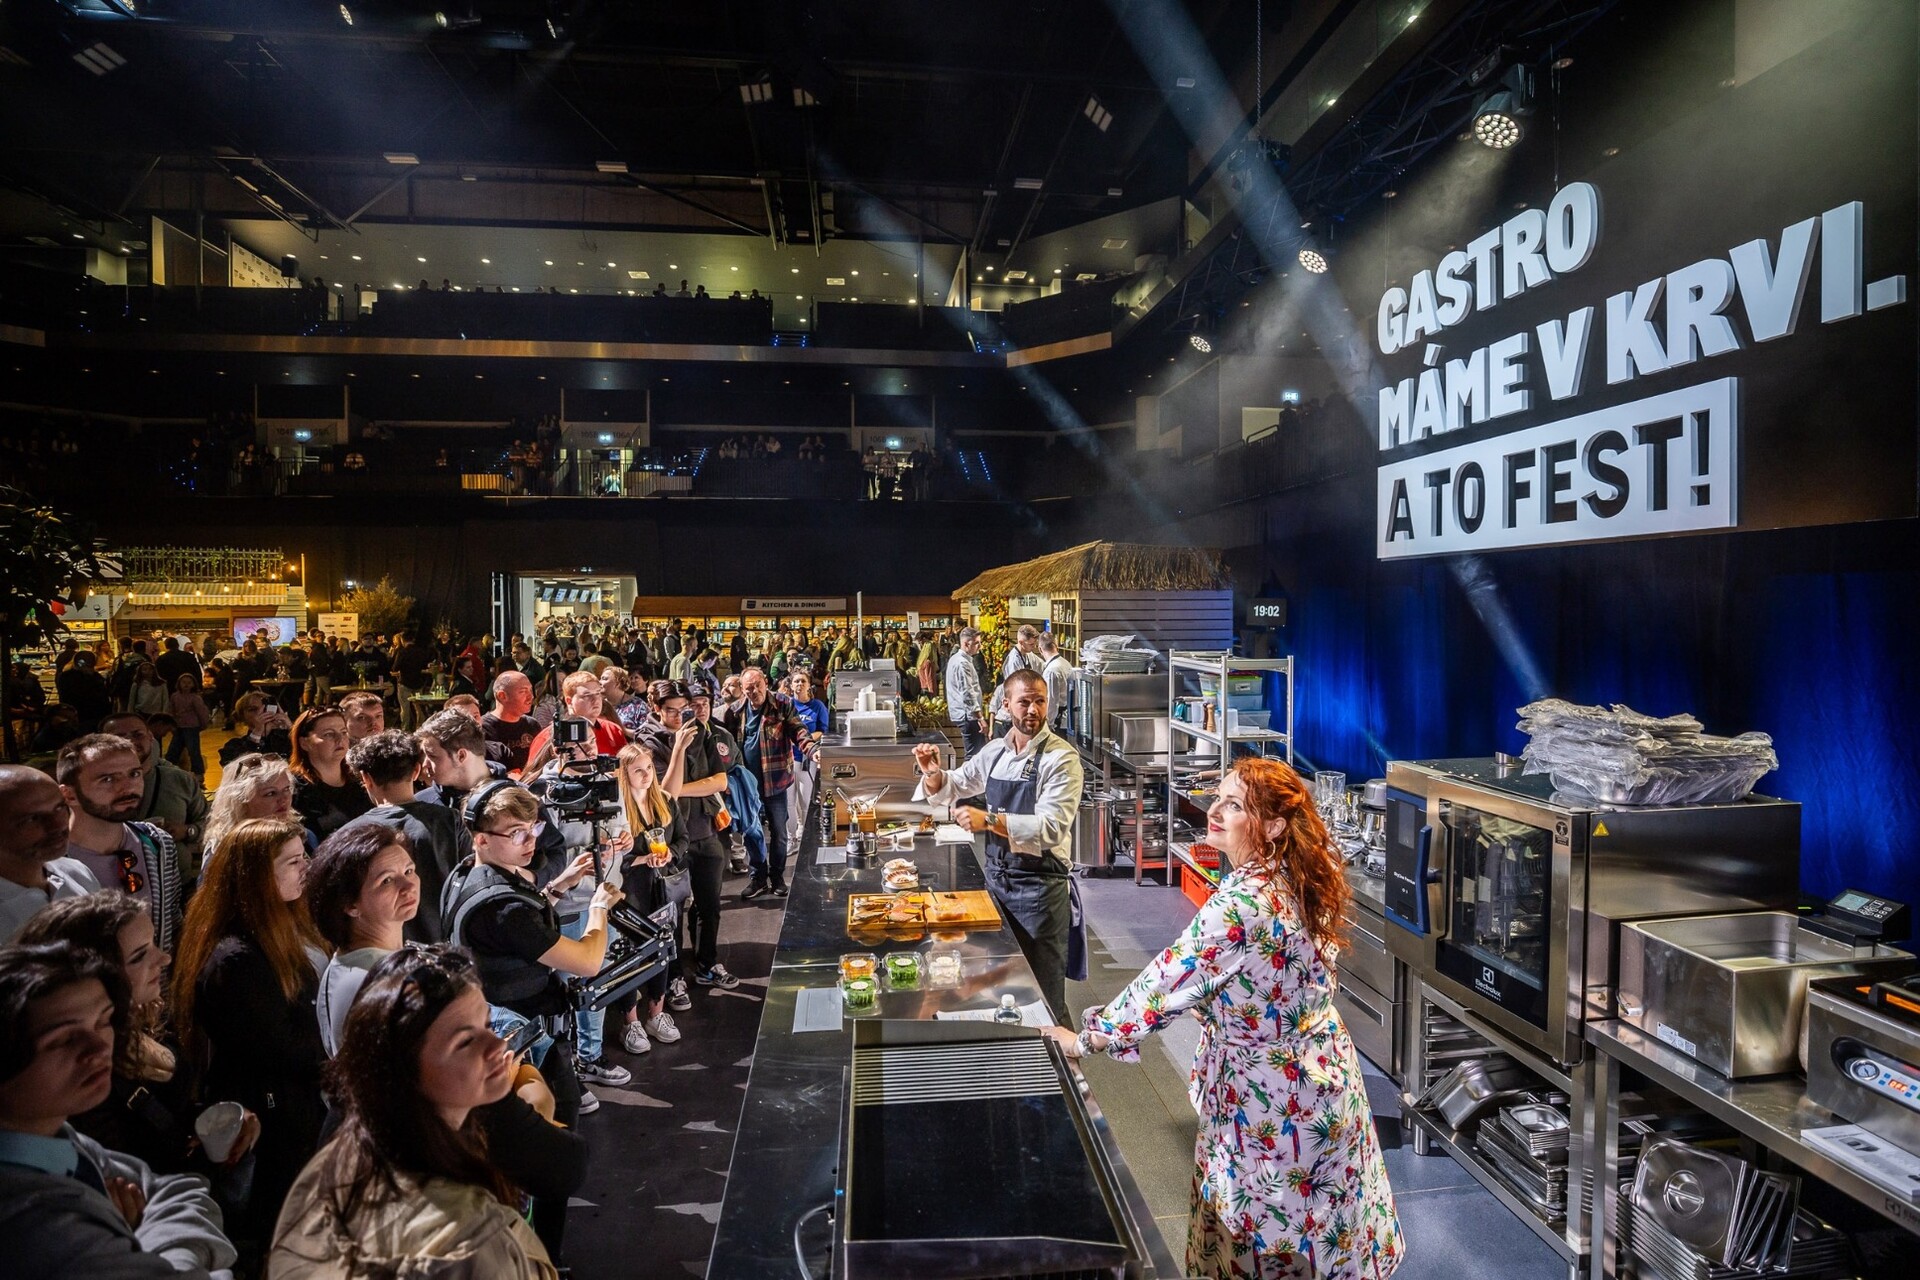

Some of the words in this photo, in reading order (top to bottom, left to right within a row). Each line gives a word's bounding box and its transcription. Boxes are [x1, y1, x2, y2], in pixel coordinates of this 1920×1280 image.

[1378, 181, 1603, 354] GASTRO
[1378, 332, 1528, 451] MÁME
[1536, 306, 1594, 400] V
[1606, 200, 1906, 385] KRVI.
[1385, 477, 1415, 543] A
[1424, 461, 1486, 537] TO
[1502, 407, 1711, 529] FEST!
[1253, 605, 1280, 617] 19:02
[1475, 978, 1502, 998] Electrolux
